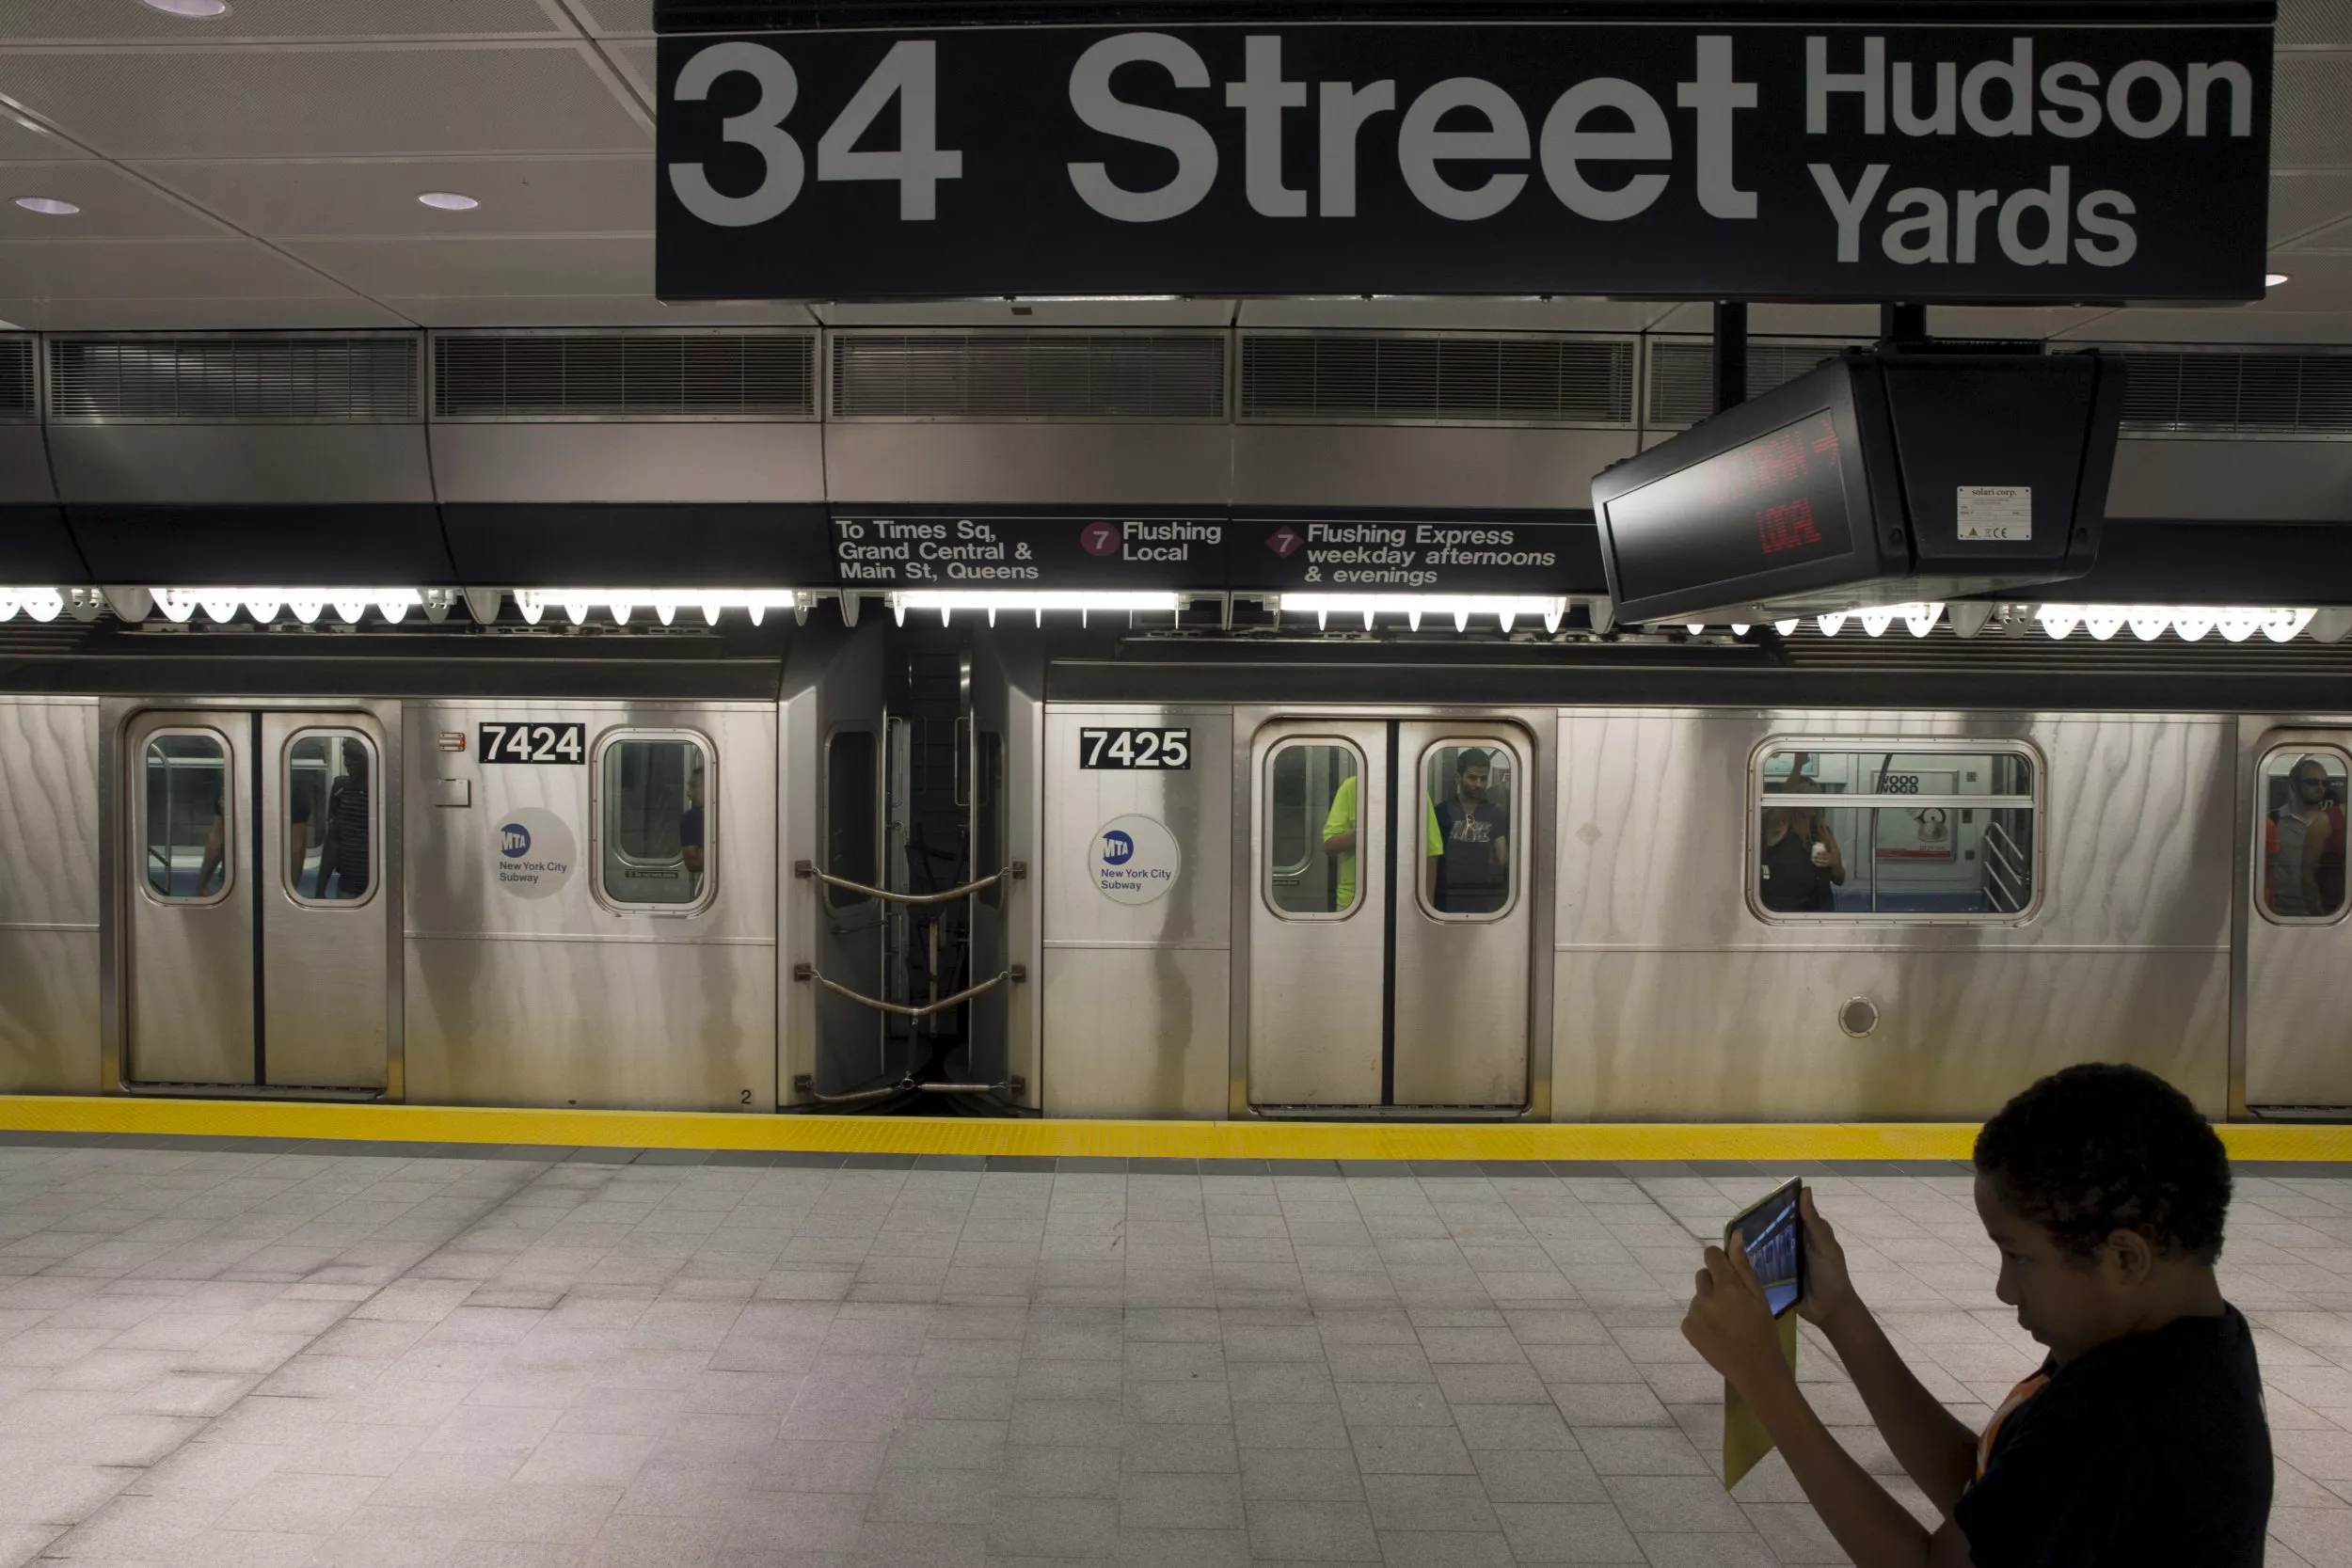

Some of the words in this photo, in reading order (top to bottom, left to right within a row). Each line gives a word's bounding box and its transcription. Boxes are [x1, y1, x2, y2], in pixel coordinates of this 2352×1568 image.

[1805, 36, 2252, 138] Hudson
[669, 40, 962, 228] 34
[1067, 32, 1757, 223] Street
[1806, 164, 2137, 267] Yards
[1972, 488, 1994, 497] solari
[835, 520, 865, 539] To
[873, 520, 947, 539] Times
[957, 520, 996, 542] Sq,
[1123, 522, 1221, 544] Flushing
[1756, 497, 1822, 554] LOCAL
[1092, 531, 1109, 550] 7
[1278, 534, 1294, 552] 7
[1308, 524, 1406, 546] Flushing
[1416, 525, 1514, 547] Express
[838, 542, 910, 560] Grand
[919, 542, 1005, 560] Central
[1014, 543, 1033, 560] &
[1123, 544, 1187, 561] Local
[1307, 546, 1416, 566] weekday
[1425, 547, 1555, 565] afternoons
[840, 562, 896, 578] Main
[905, 562, 938, 581] St,
[946, 562, 1040, 579] Queens
[1305, 566, 1322, 582] &
[1333, 567, 1438, 586] evenings
[483, 726, 581, 761] 7424
[1083, 731, 1188, 766] 7425
[501, 831, 527, 850] MTA
[1103, 838, 1129, 858] MTA
[500, 862, 522, 871] New
[523, 862, 546, 871] York
[548, 862, 567, 873] City
[1101, 869, 1123, 878] New
[1125, 869, 1149, 878] York
[1151, 869, 1171, 880] City
[500, 873, 539, 884] Subway
[1101, 880, 1141, 892] Subway
[741, 1089, 752, 1104] 2
